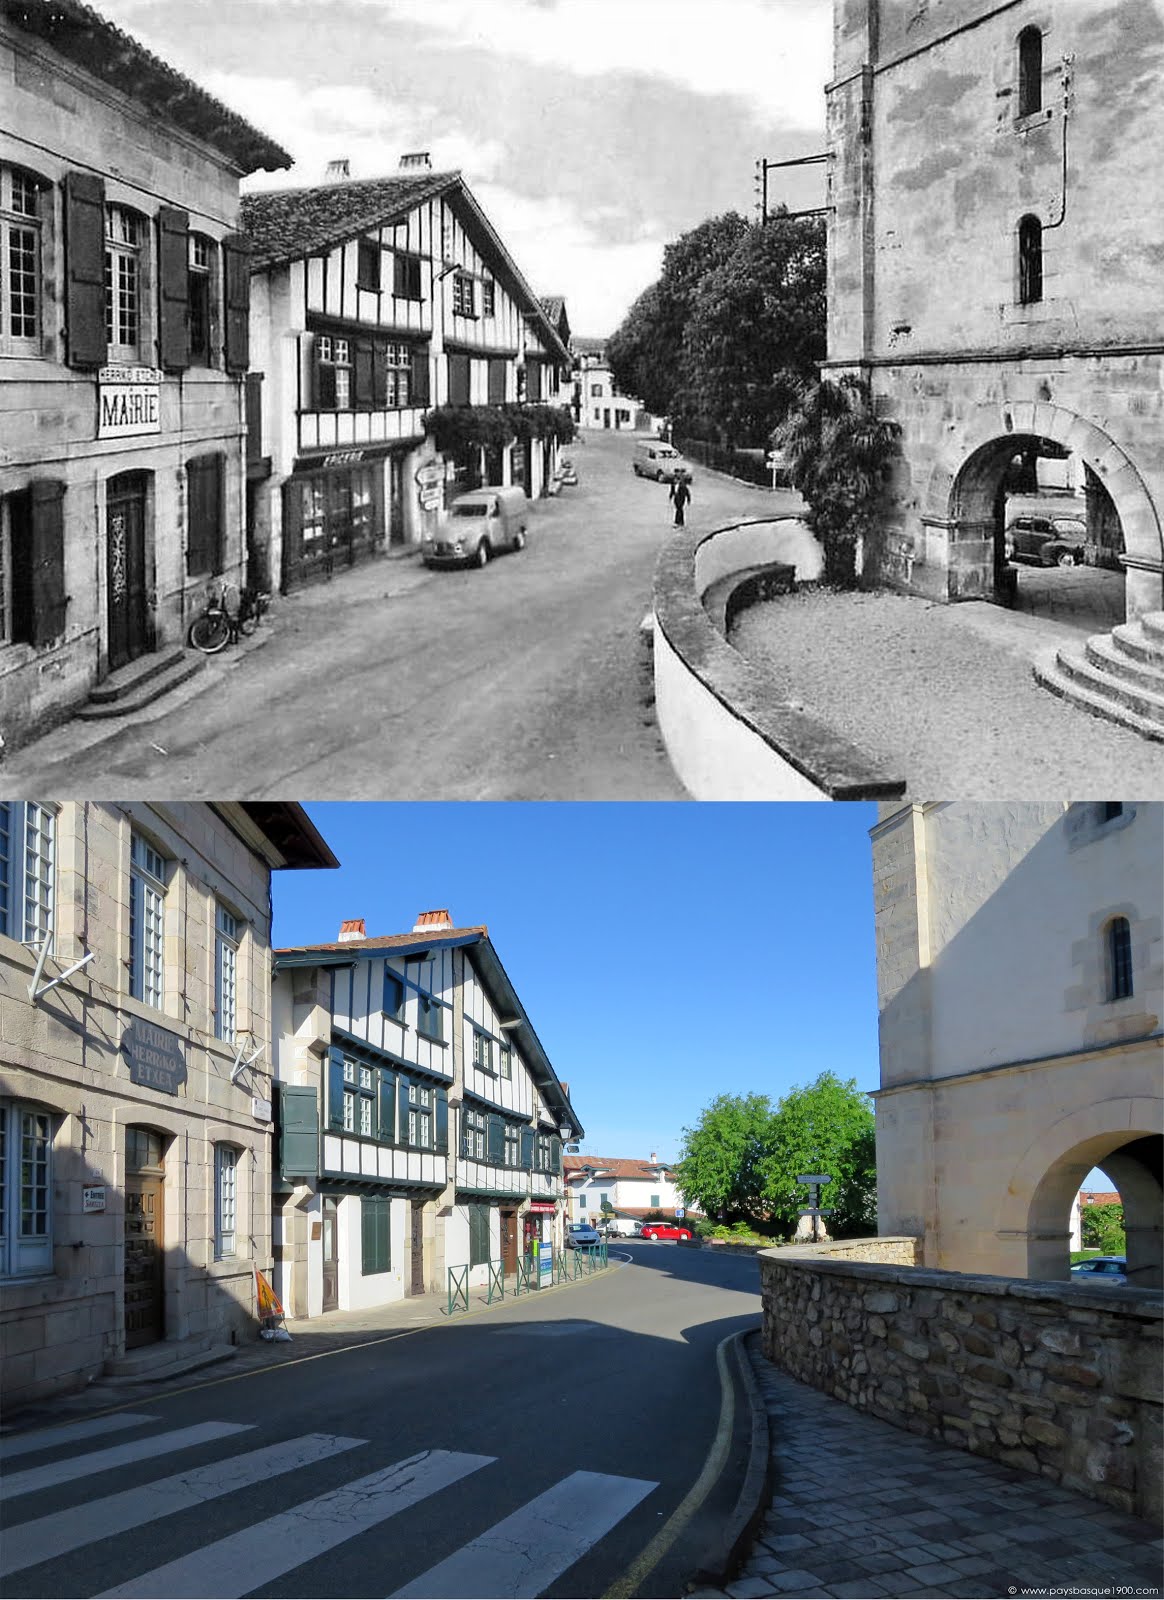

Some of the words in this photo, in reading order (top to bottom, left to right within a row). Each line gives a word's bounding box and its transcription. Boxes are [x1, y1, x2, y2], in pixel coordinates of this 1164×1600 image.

[135, 1022, 175, 1053] MAIRIE
[131, 1044, 177, 1072] HERRIKO
[138, 1064, 173, 1087] ETXEA
